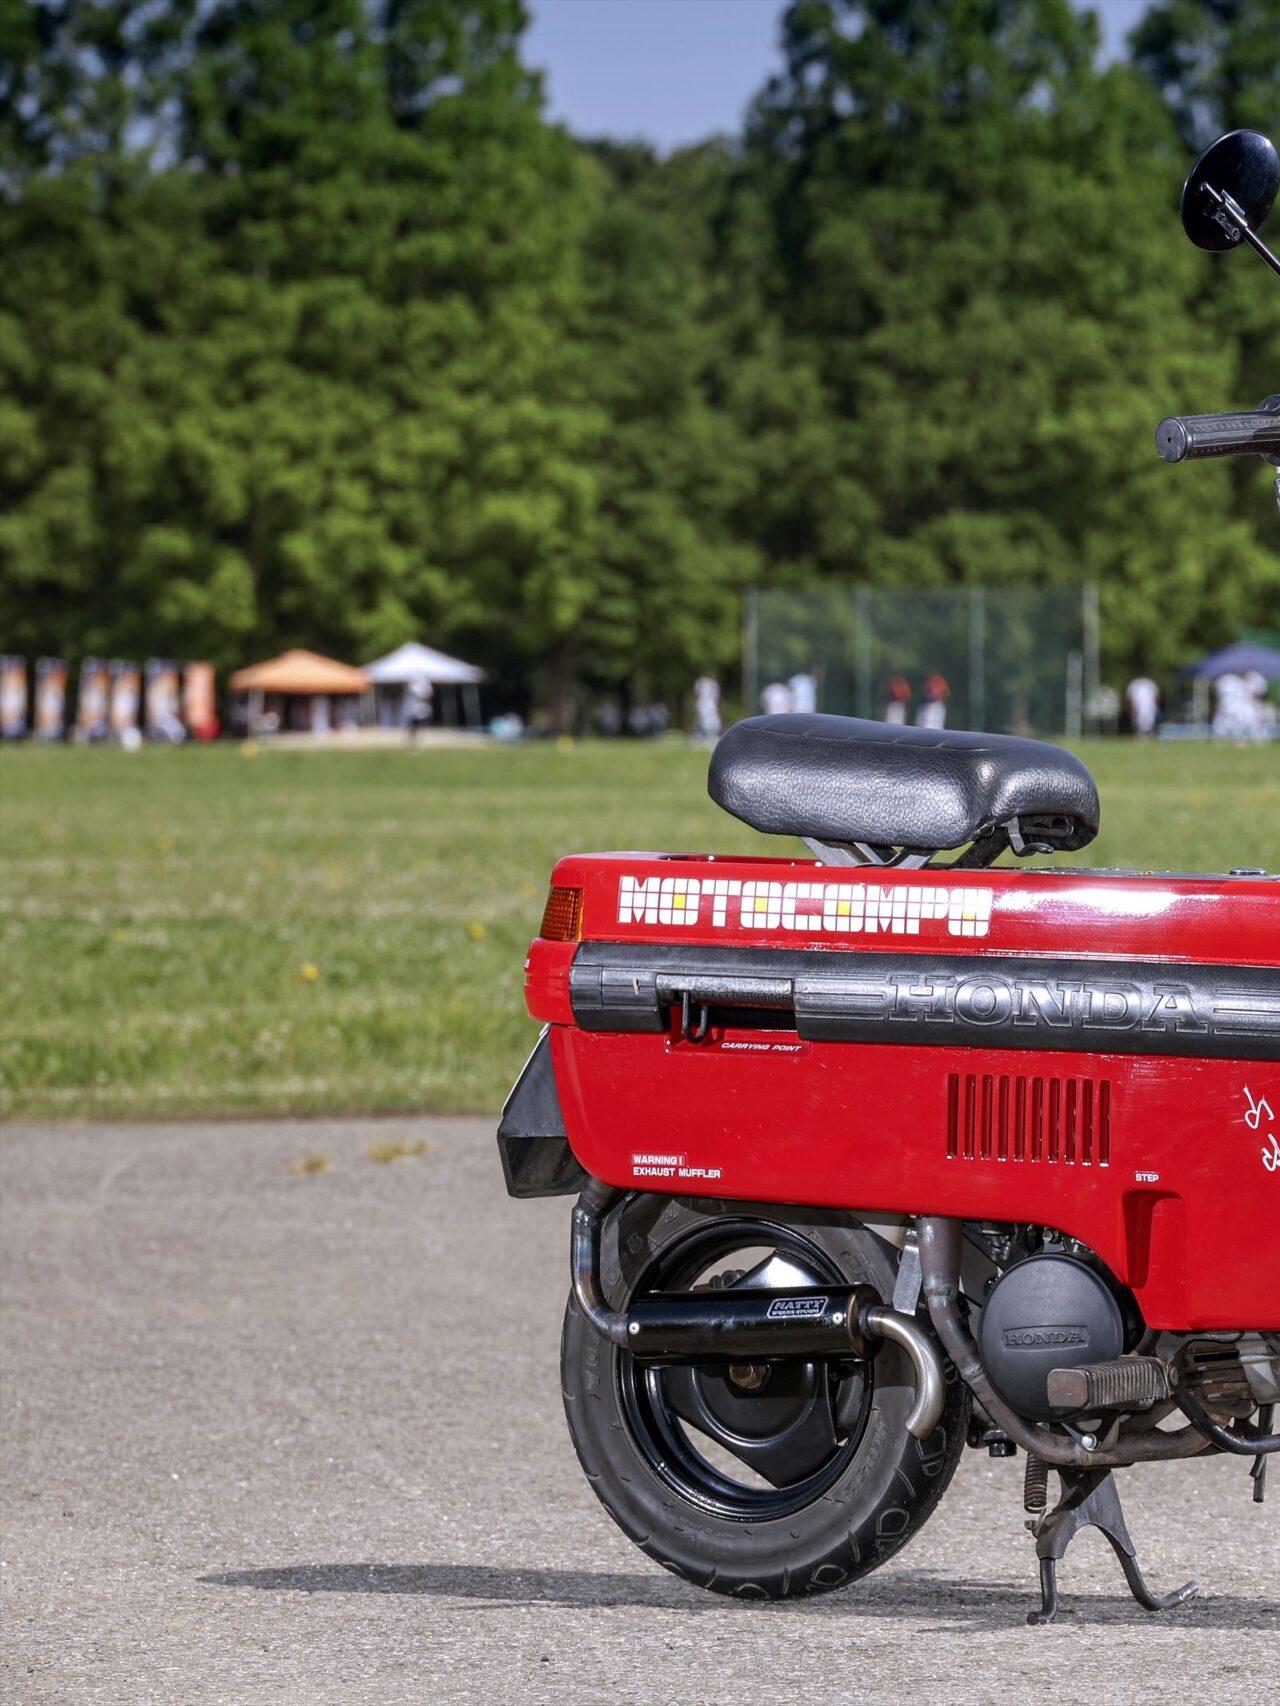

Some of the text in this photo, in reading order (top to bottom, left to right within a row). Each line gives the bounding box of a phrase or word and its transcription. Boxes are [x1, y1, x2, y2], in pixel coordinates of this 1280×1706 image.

[618, 876, 993, 937] MOTOCOMPO
[889, 975, 1208, 1034] HONDA
[721, 1042, 802, 1052] CARRYING POINT
[633, 1166, 721, 1179] EXHAUST MUFFLER
[1135, 1172, 1160, 1182] STEP
[1003, 1331, 1086, 1346] HONDA
